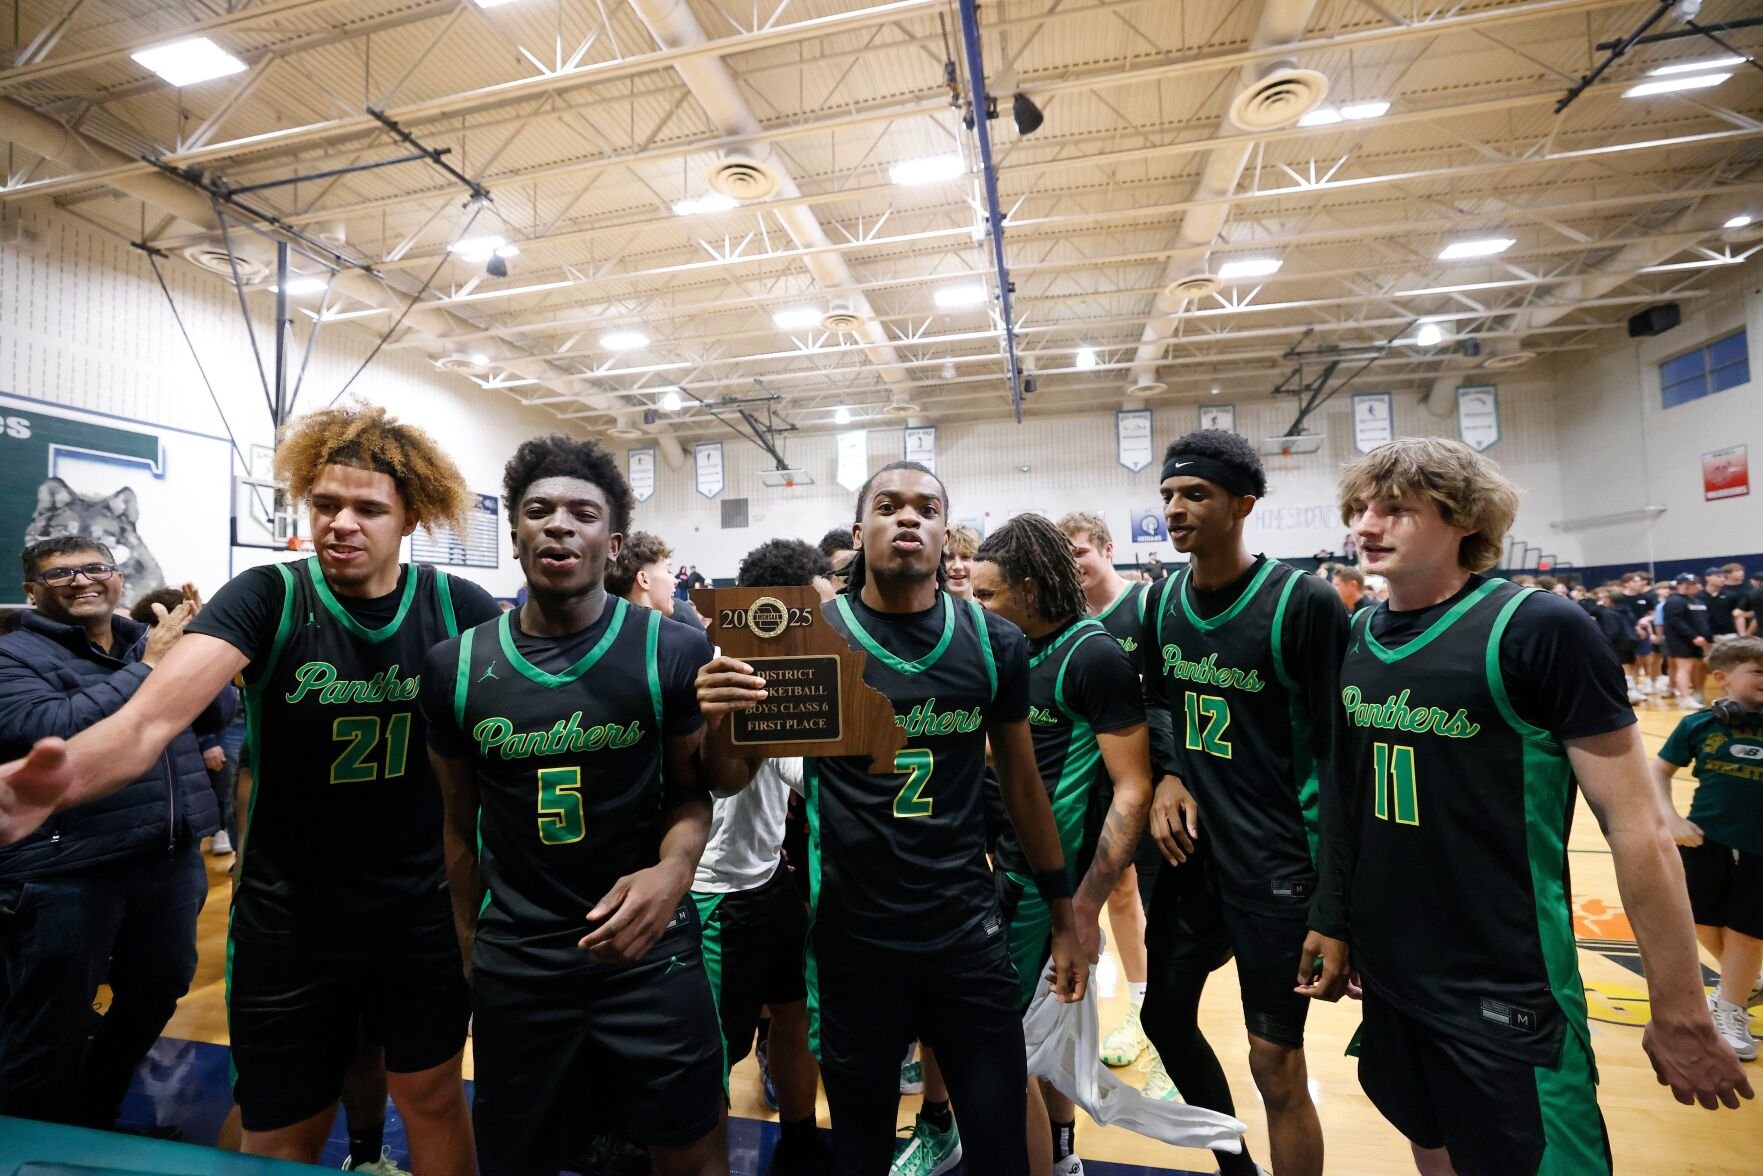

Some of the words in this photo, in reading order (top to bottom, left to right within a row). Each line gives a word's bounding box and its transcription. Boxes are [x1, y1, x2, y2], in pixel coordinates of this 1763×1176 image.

[285, 661, 421, 704] Panthe
[757, 669, 815, 680] DISTRICT
[763, 685, 828, 697] KETBALL
[1162, 643, 1265, 693] Panthers
[745, 703, 778, 715] BOYS
[780, 702, 820, 713] CLASS
[822, 701, 829, 712] 6
[747, 720, 783, 731] FIRST
[786, 718, 827, 730] PLACE
[893, 697, 983, 737] thers
[1184, 690, 1232, 760] 12
[1341, 685, 1481, 739] Panthers
[330, 712, 411, 784] 21
[473, 711, 645, 760] Panthers
[537, 766, 586, 845] 5
[893, 748, 934, 818] 2
[1373, 742, 1420, 826] 11
[678, 911, 686, 920] M
[1517, 1013, 1529, 1025] M
